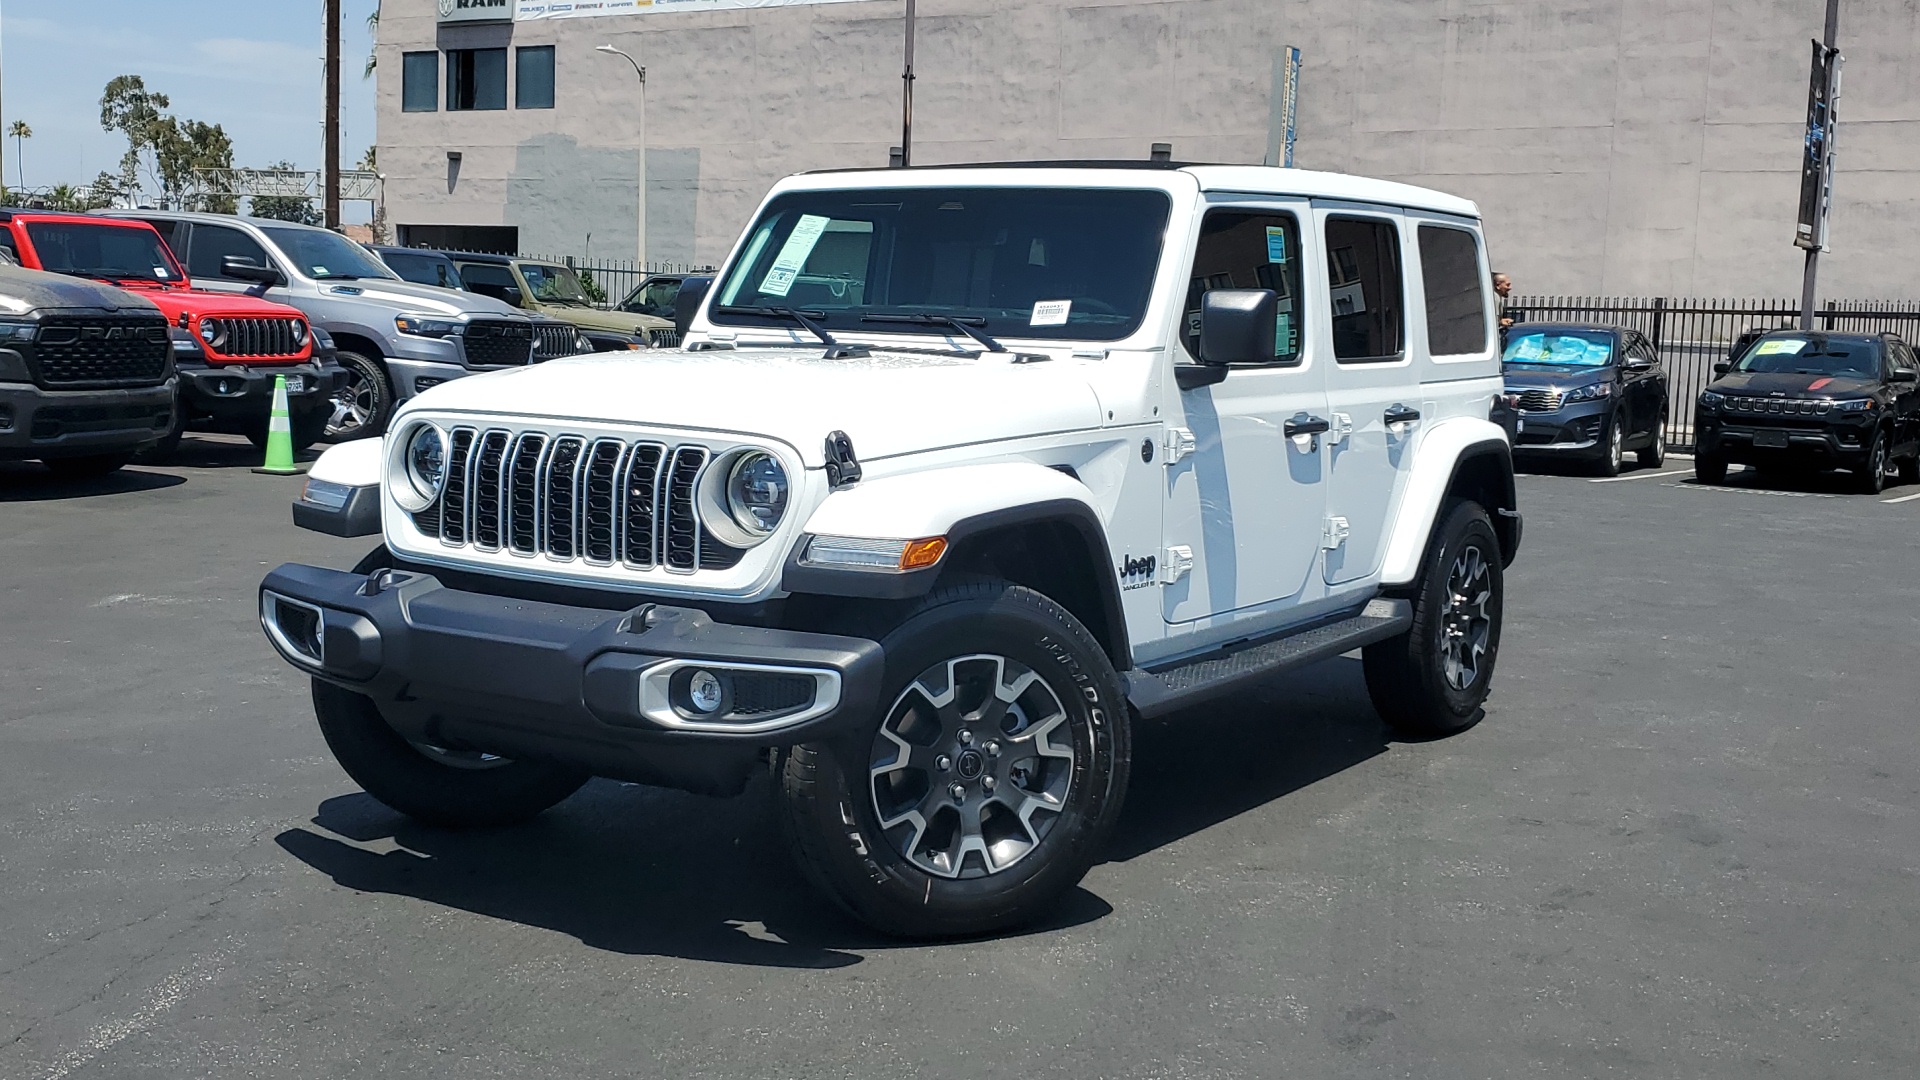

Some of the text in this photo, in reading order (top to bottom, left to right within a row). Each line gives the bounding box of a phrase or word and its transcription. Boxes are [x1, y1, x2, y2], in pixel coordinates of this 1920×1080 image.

[457, 0, 506, 9] RAM
[81, 327, 145, 340] RAM
[1119, 554, 1156, 578] Jeep
